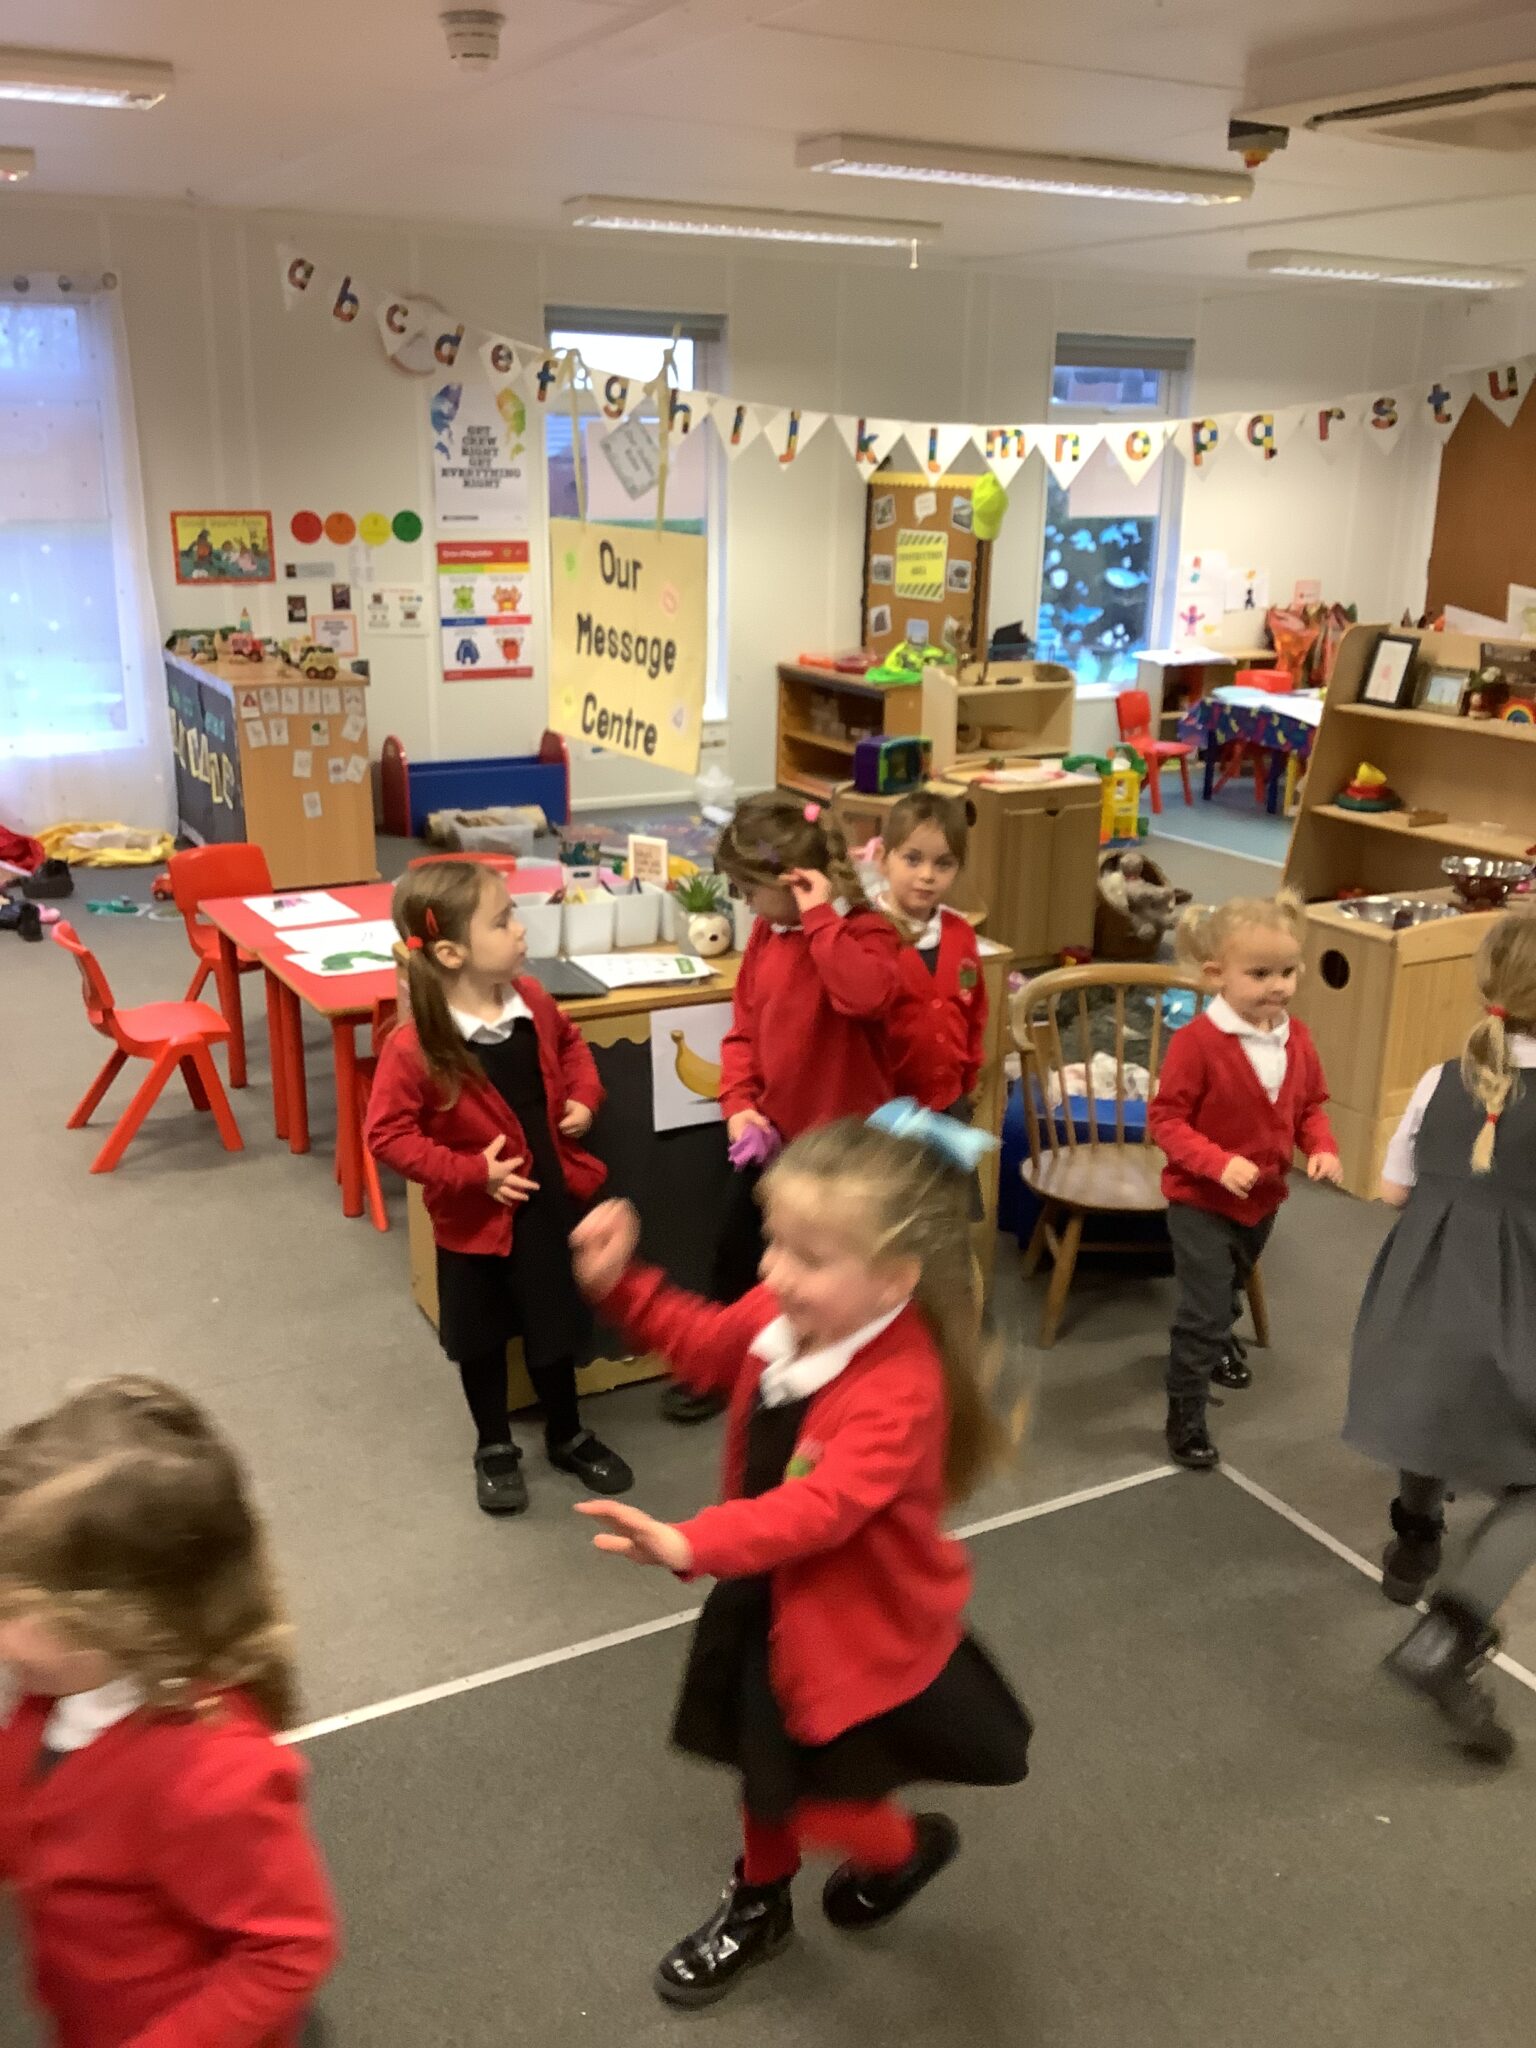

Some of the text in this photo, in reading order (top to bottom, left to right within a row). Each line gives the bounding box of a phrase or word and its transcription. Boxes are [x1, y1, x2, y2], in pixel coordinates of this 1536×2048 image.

[288, 258, 314, 290] a
[333, 275, 360, 322] b
[386, 303, 409, 334] c
[434, 323, 465, 366] d
[491, 343, 514, 373] e
[537, 360, 558, 402] f
[603, 375, 629, 419] g
[668, 388, 692, 434] h
[779, 408, 802, 463] j
[855, 418, 879, 464] k
[986, 428, 1025, 458] m
[1055, 432, 1079, 462] n
[1126, 430, 1151, 461] o
[1192, 418, 1218, 466] p
[1247, 414, 1277, 461] q
[1318, 407, 1345, 441] r
[1372, 397, 1398, 429] s
[1427, 383, 1452, 424] t
[1488, 366, 1518, 401] u
[442, 468, 522, 478] EVERYTHING
[600, 540, 642, 591] Our
[576, 611, 677, 680] Message
[581, 691, 658, 756] Centre
